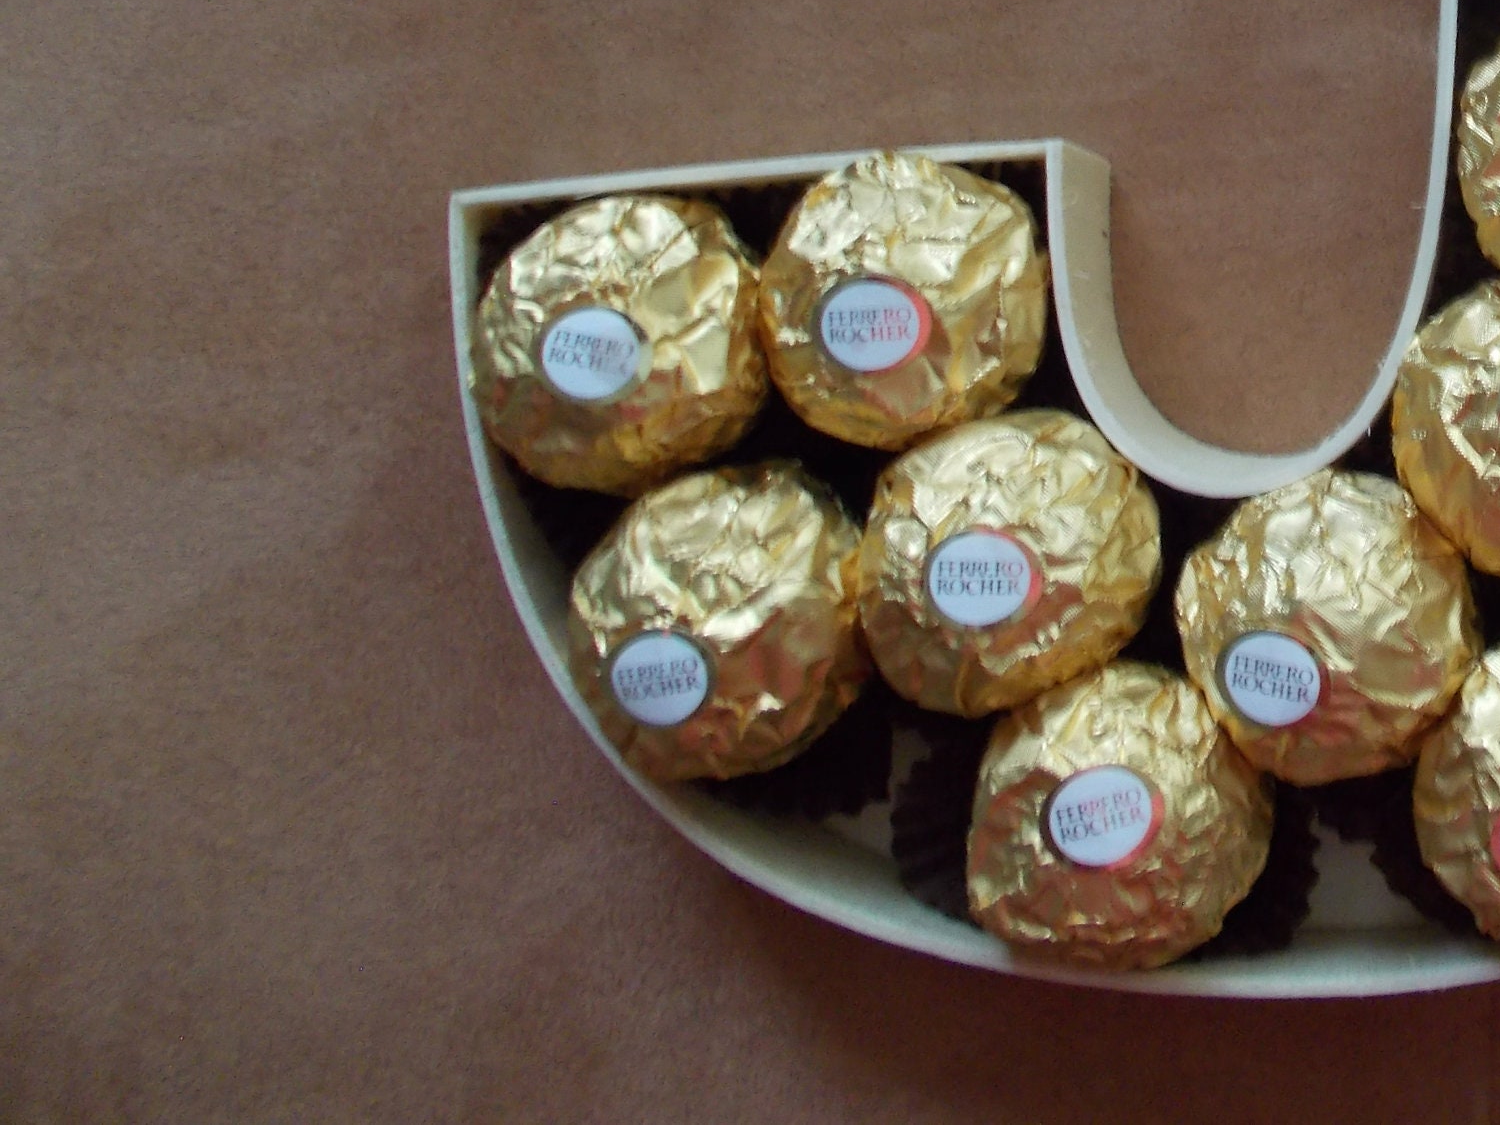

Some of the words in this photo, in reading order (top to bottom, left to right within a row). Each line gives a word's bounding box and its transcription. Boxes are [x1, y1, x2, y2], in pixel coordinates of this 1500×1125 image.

[829, 308, 911, 327] FERRERO
[554, 331, 634, 358] FERRERO
[830, 325, 911, 343] ROCHER
[550, 348, 627, 378] ROCHER
[938, 561, 1023, 578] FERRERO
[937, 579, 1025, 596] ROCHER
[617, 658, 698, 683] FERRERO
[1234, 655, 1314, 686] FERRERO
[622, 676, 698, 700] ROCHER
[1232, 672, 1309, 703] ROCHER
[1056, 787, 1141, 826] FERRERO
[1060, 806, 1145, 843] ROCHER
